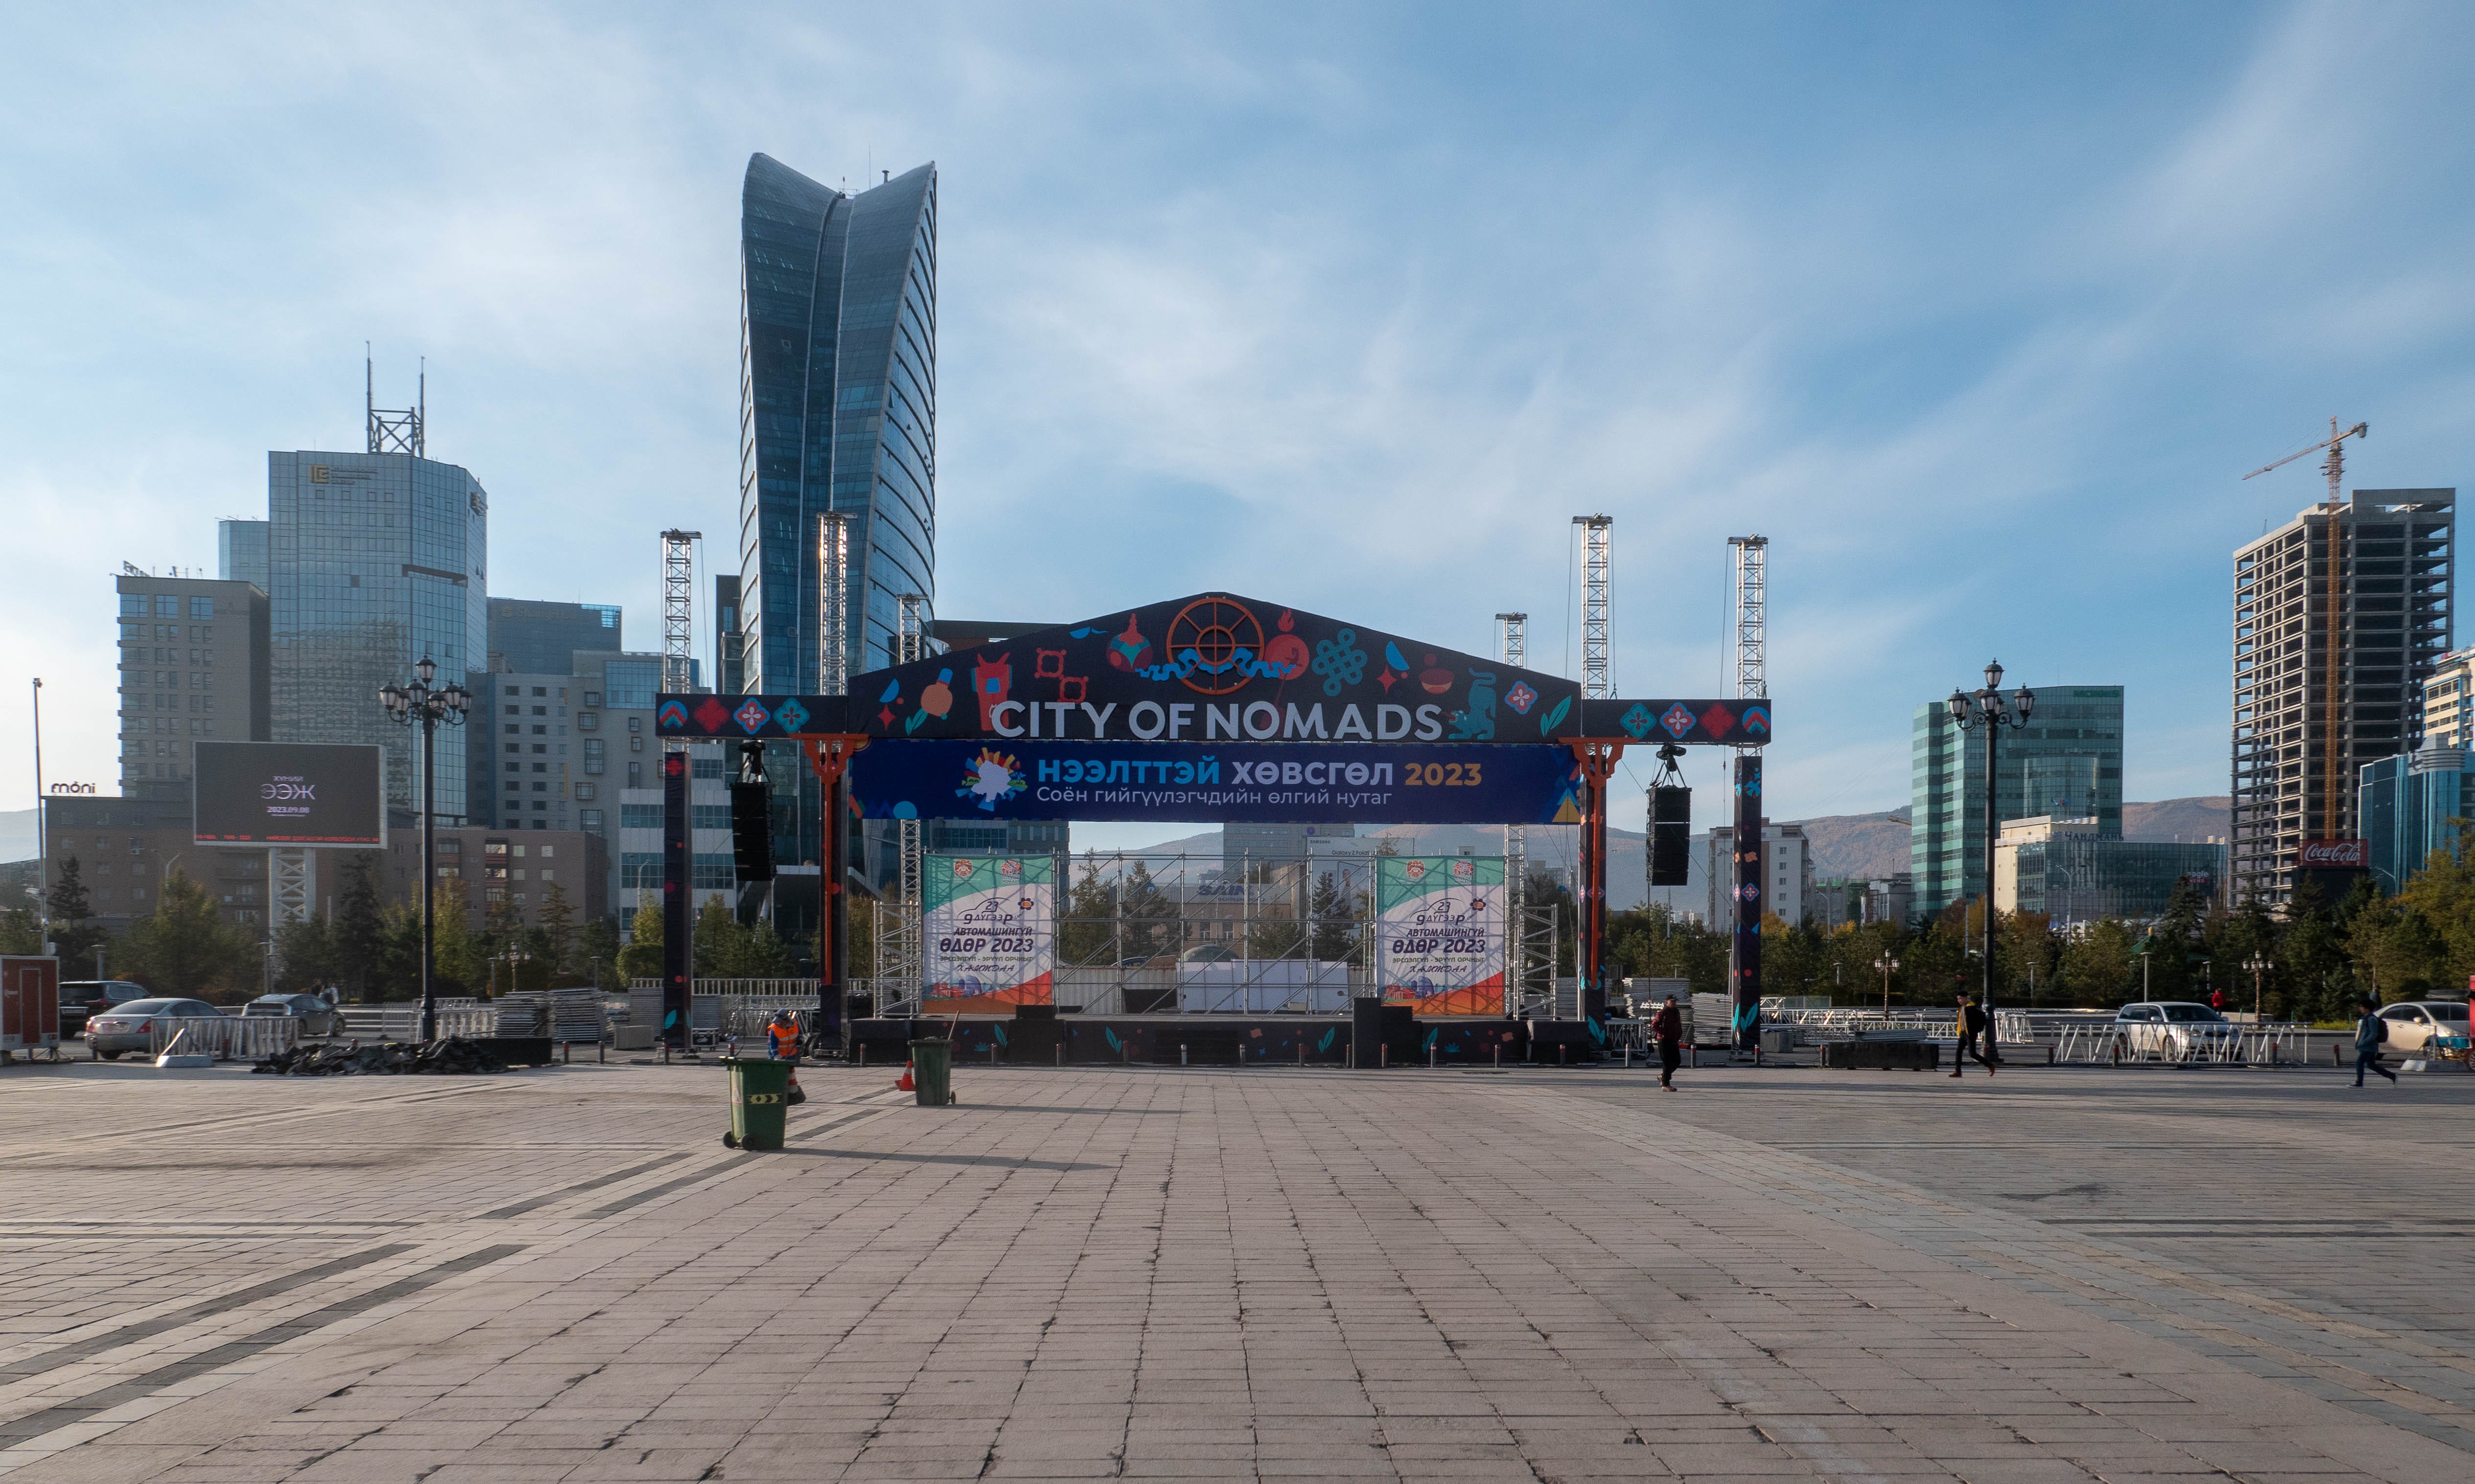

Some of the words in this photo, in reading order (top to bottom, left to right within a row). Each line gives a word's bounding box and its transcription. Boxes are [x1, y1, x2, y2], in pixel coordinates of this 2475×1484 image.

[991, 700, 1117, 738] CITY
[1128, 700, 1195, 740] OF
[1207, 700, 1443, 741] NOMADS
[1038, 755, 1219, 784] НЭЭЛТТЭЙ
[1231, 761, 1393, 786] ХӨВСГӨЛ
[1404, 763, 1482, 786] 2023
[260, 784, 316, 800] ЭЭЖ
[1037, 787, 1087, 802] Соён
[1095, 788, 1261, 806] гийгүүлэгчдийн
[1268, 789, 1330, 804] өлгий
[1337, 792, 1392, 808] нутаг
[2305, 843, 2362, 861] Coca-Cola
[981, 901, 999, 913] 23
[1434, 902, 1451, 914] 23
[963, 914, 973, 925] 9
[974, 914, 1013, 925] ДҮГЭЭР
[1416, 915, 1425, 926] 9
[1426, 915, 1465, 926] ДҮГЭЭР
[954, 927, 1033, 936] АВТОМАШИНГҮЙ
[1407, 928, 1484, 937] АВТОМАШИНГҮЙ
[940, 938, 986, 952] ӨДӨР
[991, 938, 1034, 952] 2023
[1393, 939, 1439, 953] ӨДӨР
[1443, 939, 1486, 953] 2023
